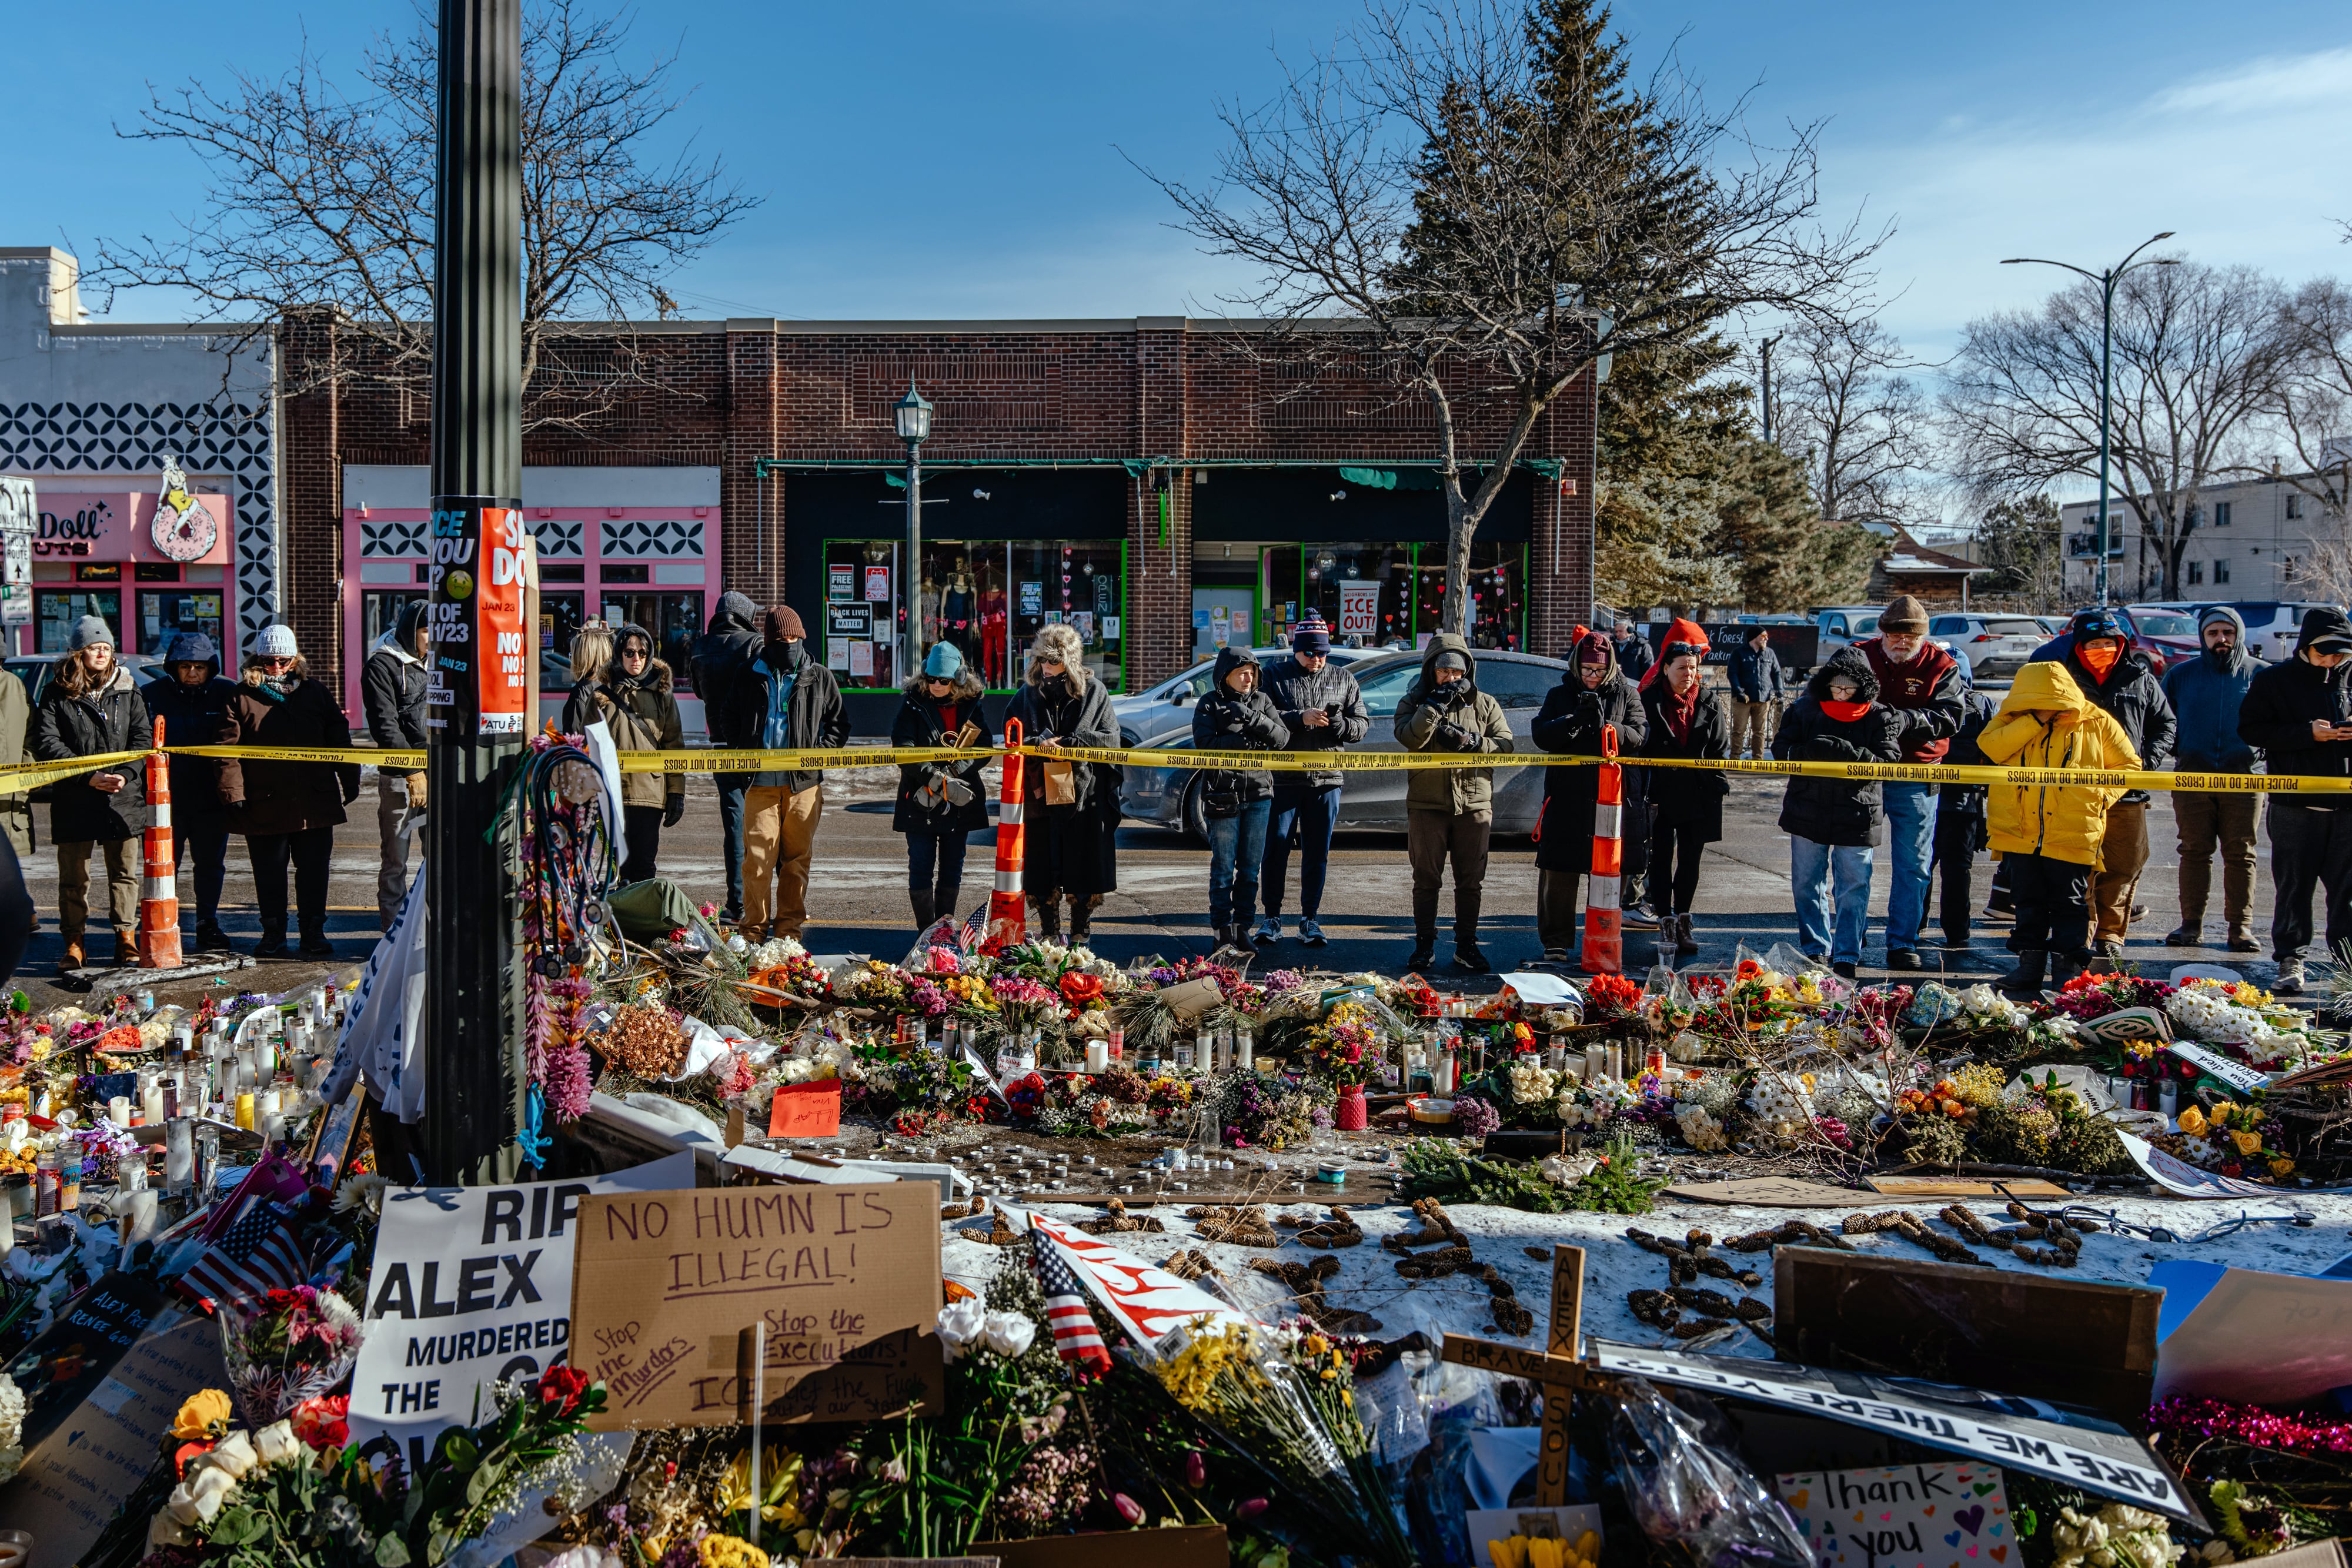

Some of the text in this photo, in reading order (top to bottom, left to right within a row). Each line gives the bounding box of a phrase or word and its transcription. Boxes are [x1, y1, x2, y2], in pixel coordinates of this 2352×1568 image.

[38, 510, 101, 540] Doll
[7, 537, 27, 547] TRUCK
[32, 542, 89, 555] UTS
[7, 549, 28, 560] ROUTE
[831, 575, 851, 584] FREE
[1098, 575, 1107, 612] OPEN
[439, 603, 462, 622] OF
[482, 602, 515, 612] JAN 23
[1344, 598, 1374, 614] ICE
[435, 623, 469, 643] 1/23
[1344, 616, 1376, 631] OUT!
[497, 632, 521, 654] NO
[439, 657, 455, 669] JAN
[454, 661, 468, 672] 23
[502, 656, 520, 673] NO
[508, 675, 519, 687] NO
[486, 721, 506, 729] ATU
[384, 757, 426, 766] NOT CROSS
[664, 758, 760, 770] POLICE LINE DO NOT CROSS
[801, 755, 896, 767] POLICE LINE DO NOT CROSS
[1034, 745, 1128, 762] POLICE LINE DO NOT CROSS
[1167, 756, 1190, 765] CROSS
[1192, 757, 1207, 765] NOT
[1755, 762, 1772, 771] LINE
[1775, 763, 1802, 773] POLICE
[1847, 765, 1959, 780] POLICE LINE DO NOT CROSS
[2008, 771, 2125, 785] POLICE LINE DO NOT CROSS
[2176, 776, 2298, 790] POLICE LINE DO NOT CROSS
[2198, 1054, 2249, 1089] You died
[2082, 1088, 2101, 1112] THANK
[793, 1109, 834, 1125] LLAP
[482, 1184, 591, 1245] RIP
[606, 1192, 893, 1241] NO HUMN IS
[667, 1243, 857, 1291] ILLEGAL!
[368, 1248, 543, 1319] ALEX
[92, 1290, 129, 1314] ALEX
[1553, 1255, 1574, 1352] ALEX
[68, 1309, 113, 1333] RENEE
[763, 1308, 866, 1338] Stop the
[406, 1318, 570, 1367] MURDERED
[593, 1320, 640, 1355] Stop
[763, 1328, 909, 1367] Executions!
[594, 1354, 633, 1383] the
[1461, 1342, 1544, 1375] BRAVE
[1617, 1358, 1772, 1395] YET?
[382, 1379, 440, 1415] THE
[832, 1375, 870, 1400] the
[766, 1402, 793, 1417] out
[828, 1400, 857, 1415] our
[1779, 1386, 1970, 1443] THERE
[1977, 1427, 2057, 1467] WE
[2065, 1451, 2171, 1500] ARE
[1823, 1465, 1953, 1510] Thank
[1848, 1521, 1923, 1568] you
